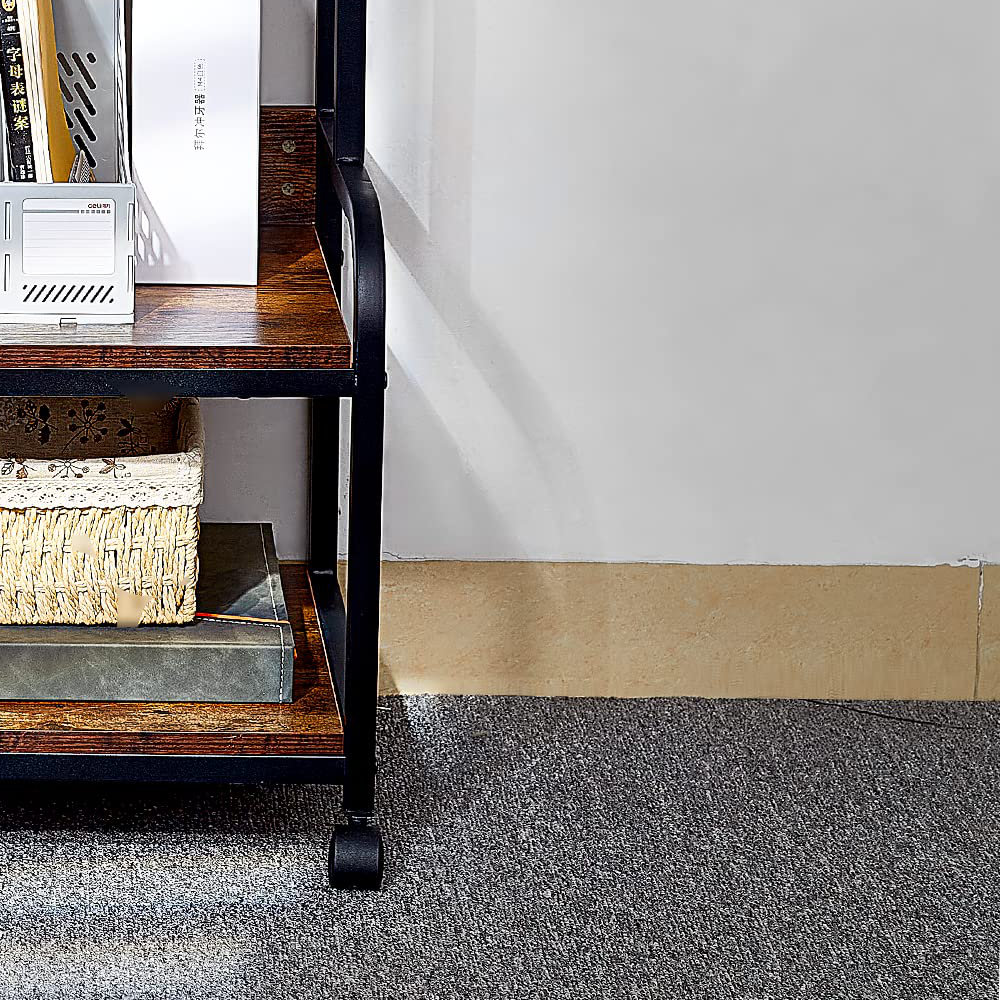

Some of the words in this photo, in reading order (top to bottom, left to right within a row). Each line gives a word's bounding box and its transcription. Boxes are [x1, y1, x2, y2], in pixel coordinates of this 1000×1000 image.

[6, 47, 29, 131] 字母表谜案
[194, 94, 206, 151] 拜尔冲牙器
